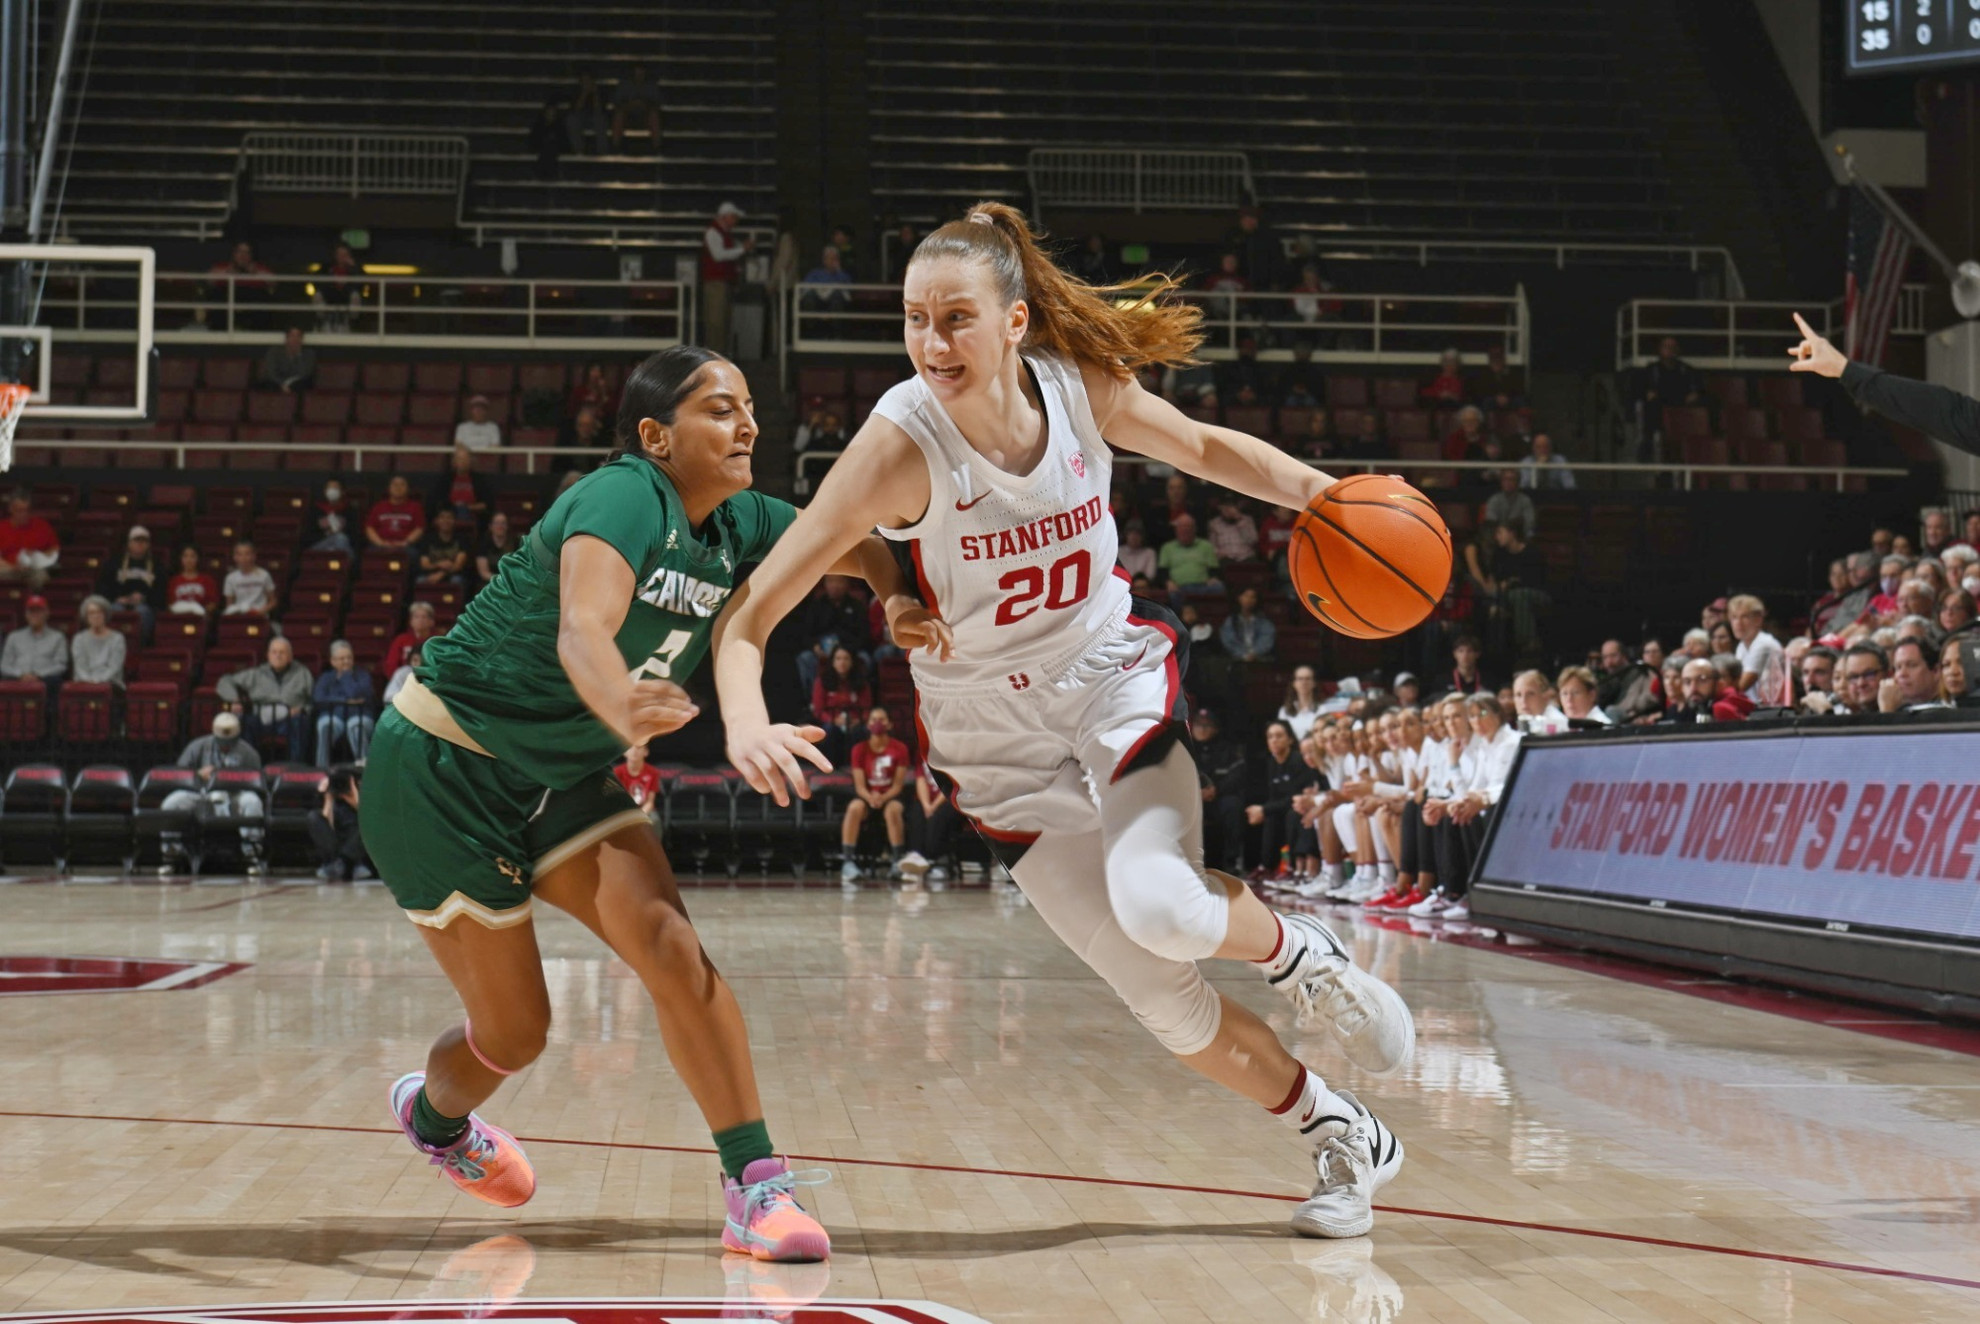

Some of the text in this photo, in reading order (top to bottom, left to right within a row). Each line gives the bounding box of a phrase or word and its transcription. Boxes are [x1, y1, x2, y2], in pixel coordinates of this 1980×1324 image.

[1861, 28, 1890, 51] 35
[1916, 23, 1932, 45] 0
[1862, 0, 1931, 22] 15 2
[961, 495, 1102, 561] STANFORD
[994, 549, 1091, 626] 20
[1549, 780, 1980, 880] STANFORD WOMEN'S BASKE
